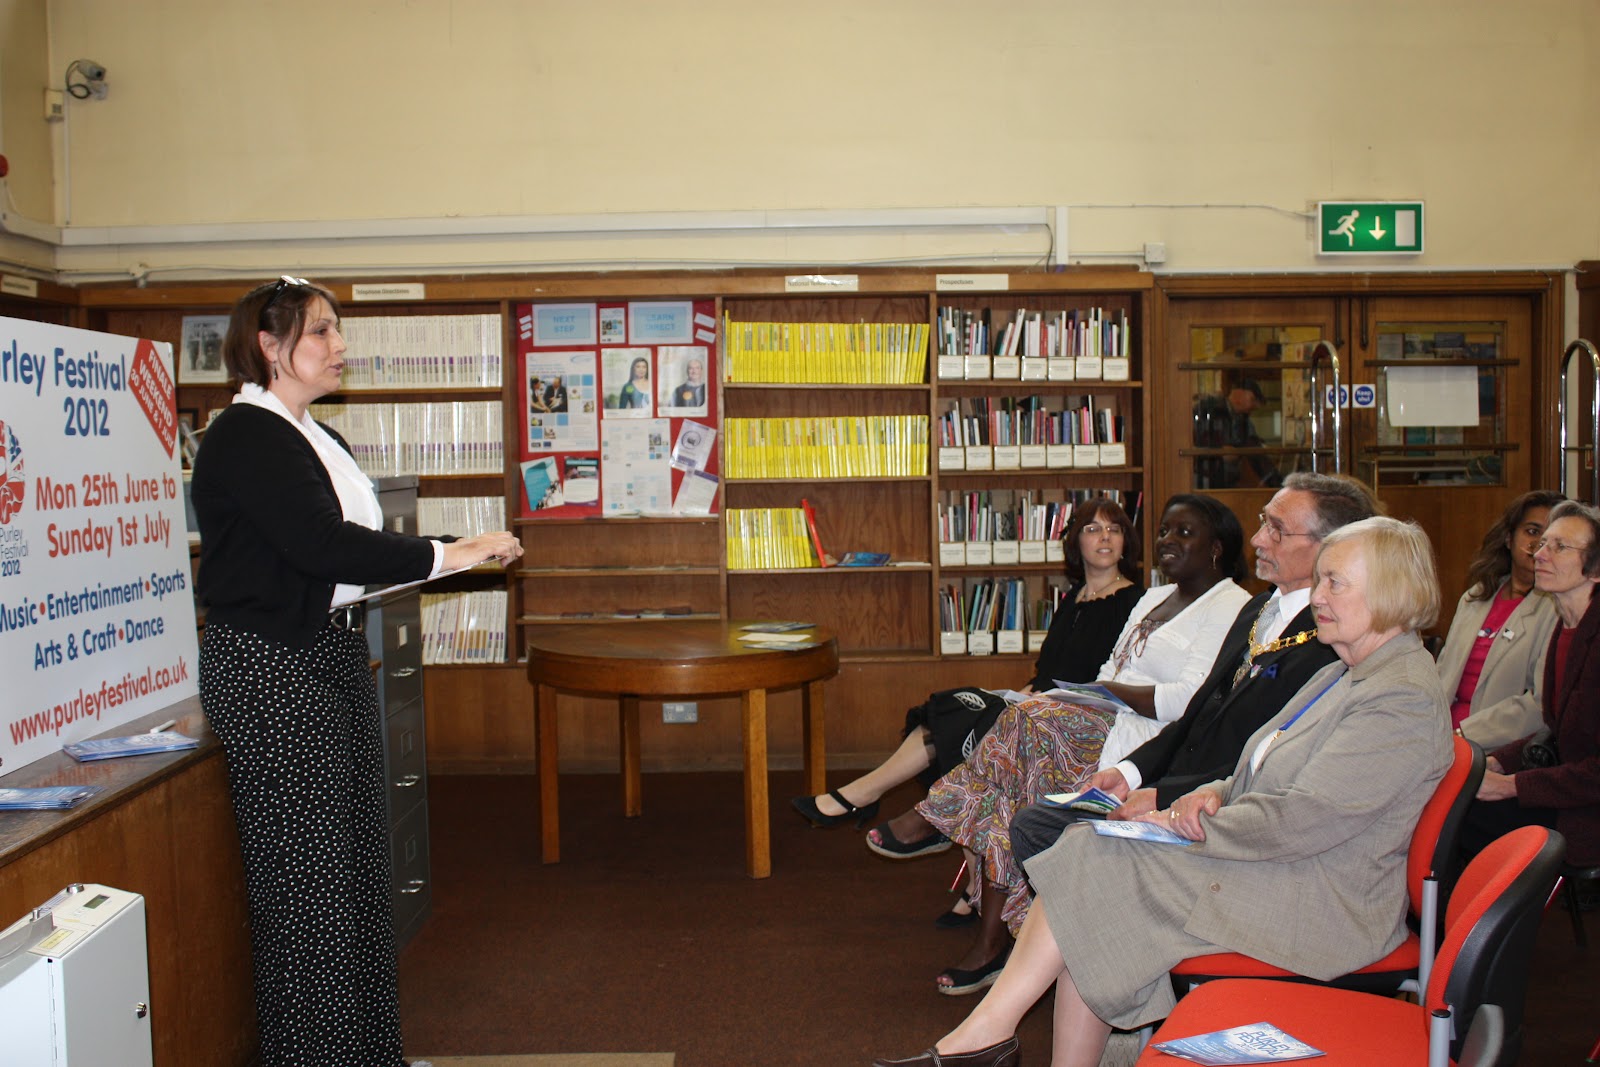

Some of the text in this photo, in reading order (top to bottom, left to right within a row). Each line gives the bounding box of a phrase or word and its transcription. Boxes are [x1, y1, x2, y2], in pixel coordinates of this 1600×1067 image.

[553, 315, 576, 323] NEXT
[554, 325, 576, 333] STEP
[54, 347, 127, 392] Festival
[148, 349, 173, 400] FINALE
[131, 369, 140, 387] 30
[139, 385, 154, 413] JUNE
[162, 425, 174, 449] JULY
[139, 359, 173, 428] WEEKEND
[64, 396, 110, 437] 2012
[36, 471, 176, 511] Mon 25th June to
[1, 540, 29, 560] Festival
[47, 511, 170, 558] Sunday 1st July
[2, 559, 21, 577] 2012
[47, 576, 144, 621] Entertainment
[151, 568, 186, 601] Sports
[34, 616, 164, 671] Arts & Craft Dance
[10, 656, 188, 746] www.purleyfestival.co.uk
[1234, 1032, 1284, 1056] FESTIVAL
[1250, 1031, 1292, 1051] PURLEY
